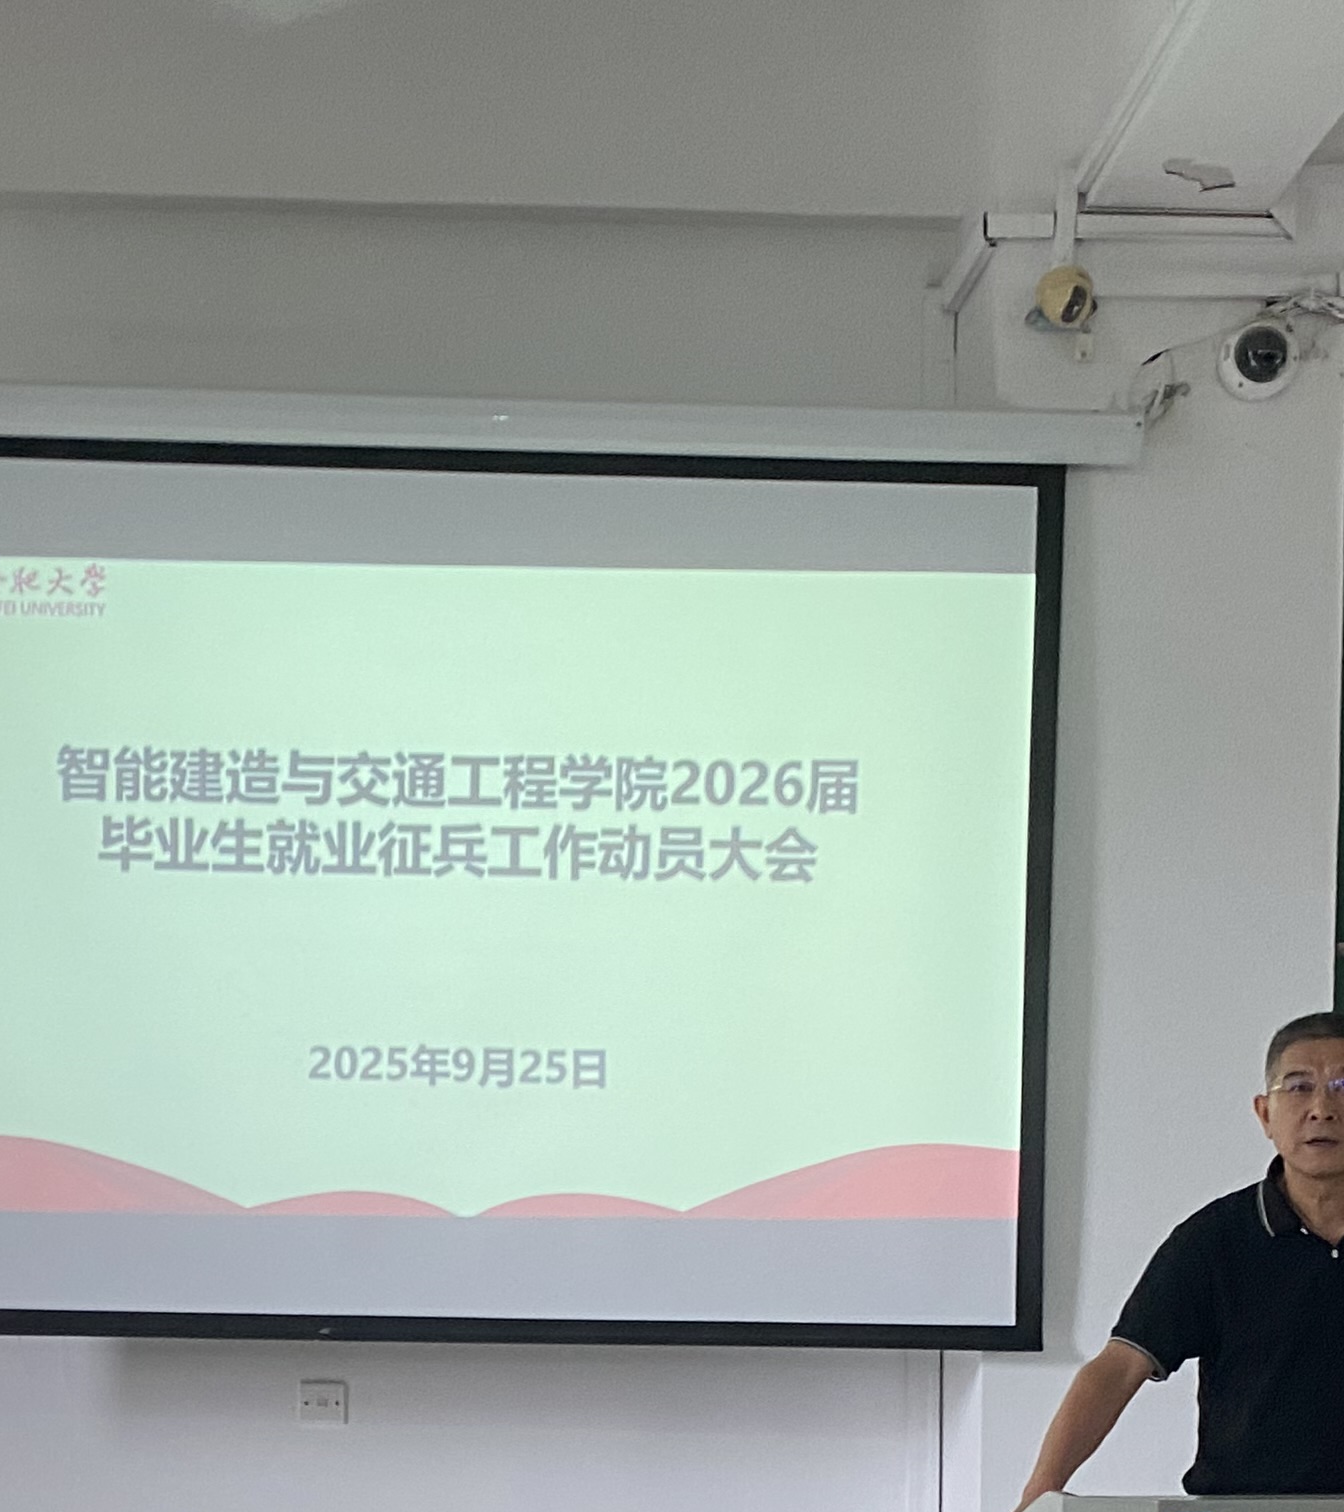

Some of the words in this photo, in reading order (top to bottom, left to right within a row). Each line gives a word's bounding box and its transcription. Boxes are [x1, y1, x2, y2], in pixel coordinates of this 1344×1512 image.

[20, 602, 106, 617] UNIVERSITY
[56, 744, 859, 815] 智能建造与交通工程学院2026届
[98, 815, 819, 883] 毕业生就业征兵工作动员大会
[307, 1043, 607, 1090] 2025年9月25日
